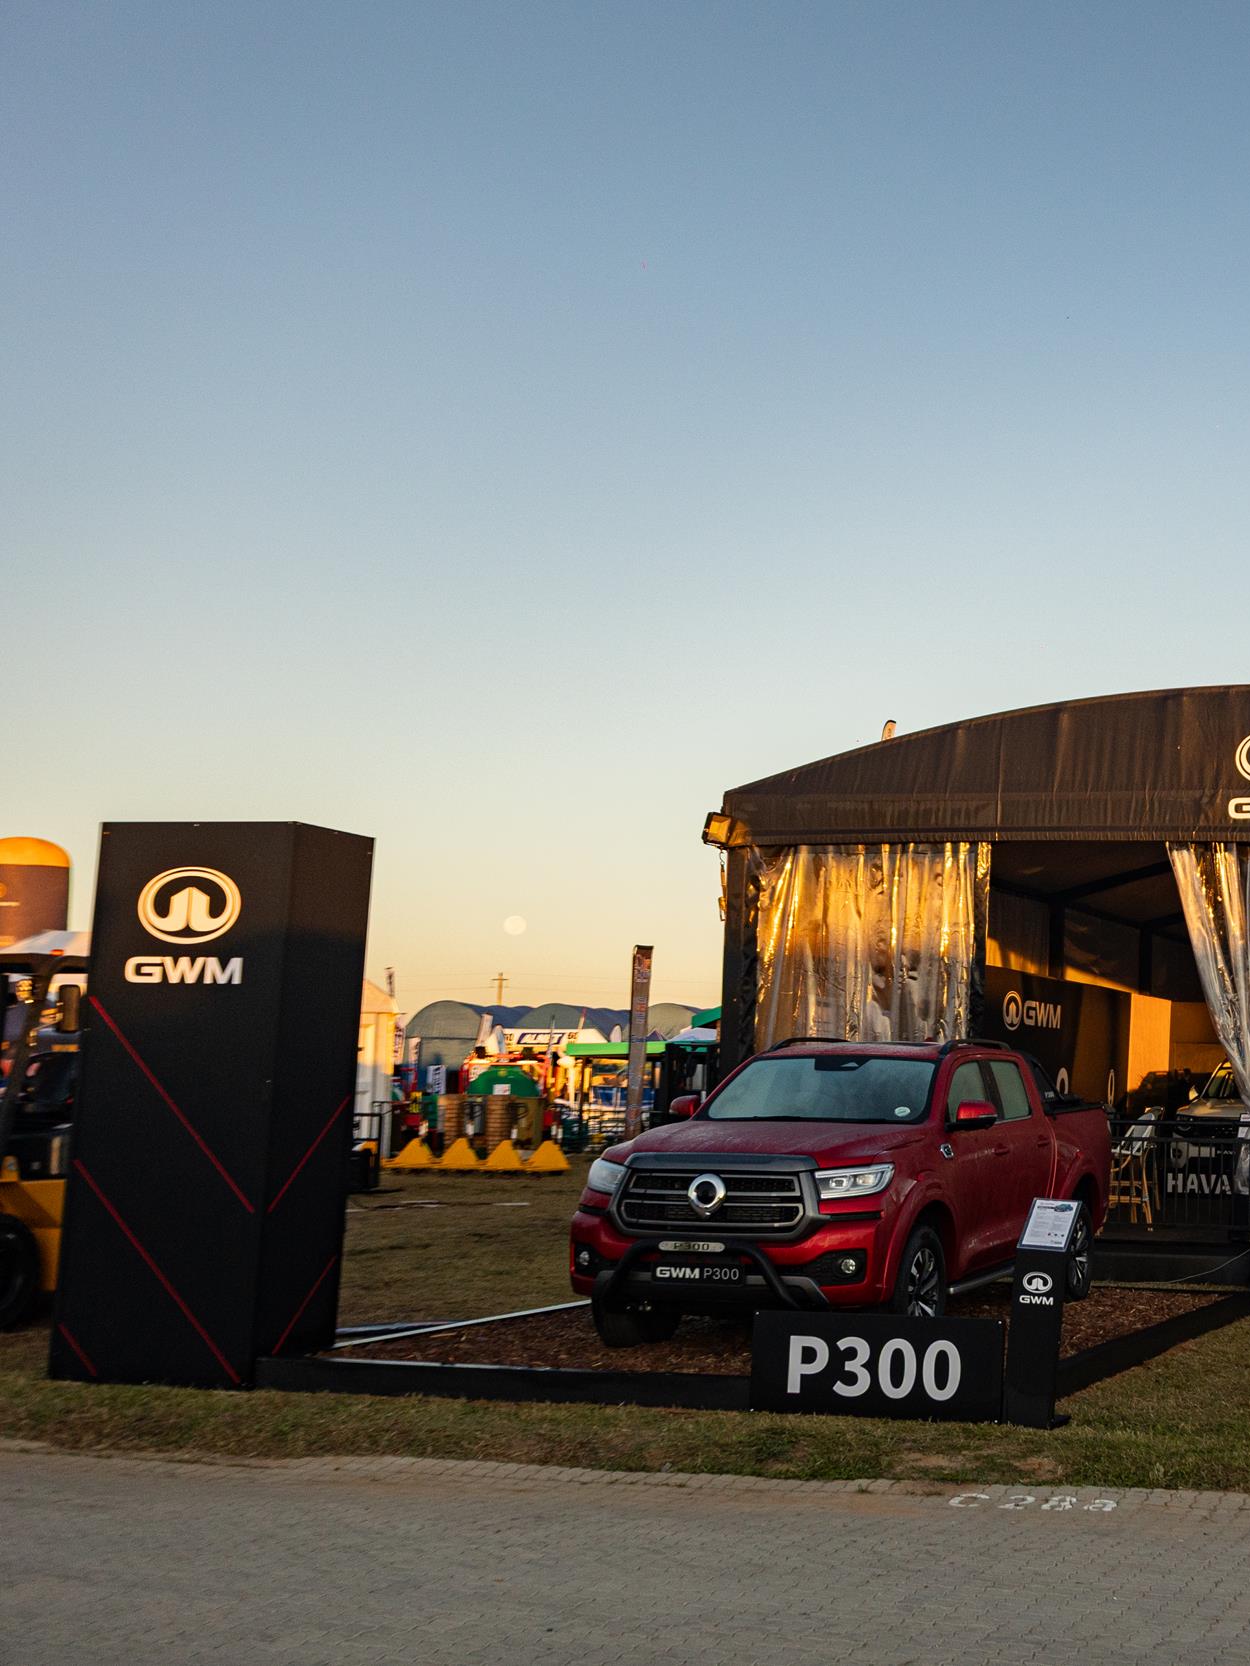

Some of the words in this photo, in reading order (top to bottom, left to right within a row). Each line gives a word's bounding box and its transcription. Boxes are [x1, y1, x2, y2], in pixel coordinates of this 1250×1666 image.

[125, 956, 243, 984] GWM
[1023, 1000, 1062, 1029] GWM
[656, 1266, 700, 1279] GWM
[703, 1267, 740, 1280] P300
[1019, 1295, 1054, 1305] GWM
[787, 1335, 962, 1401] P300
